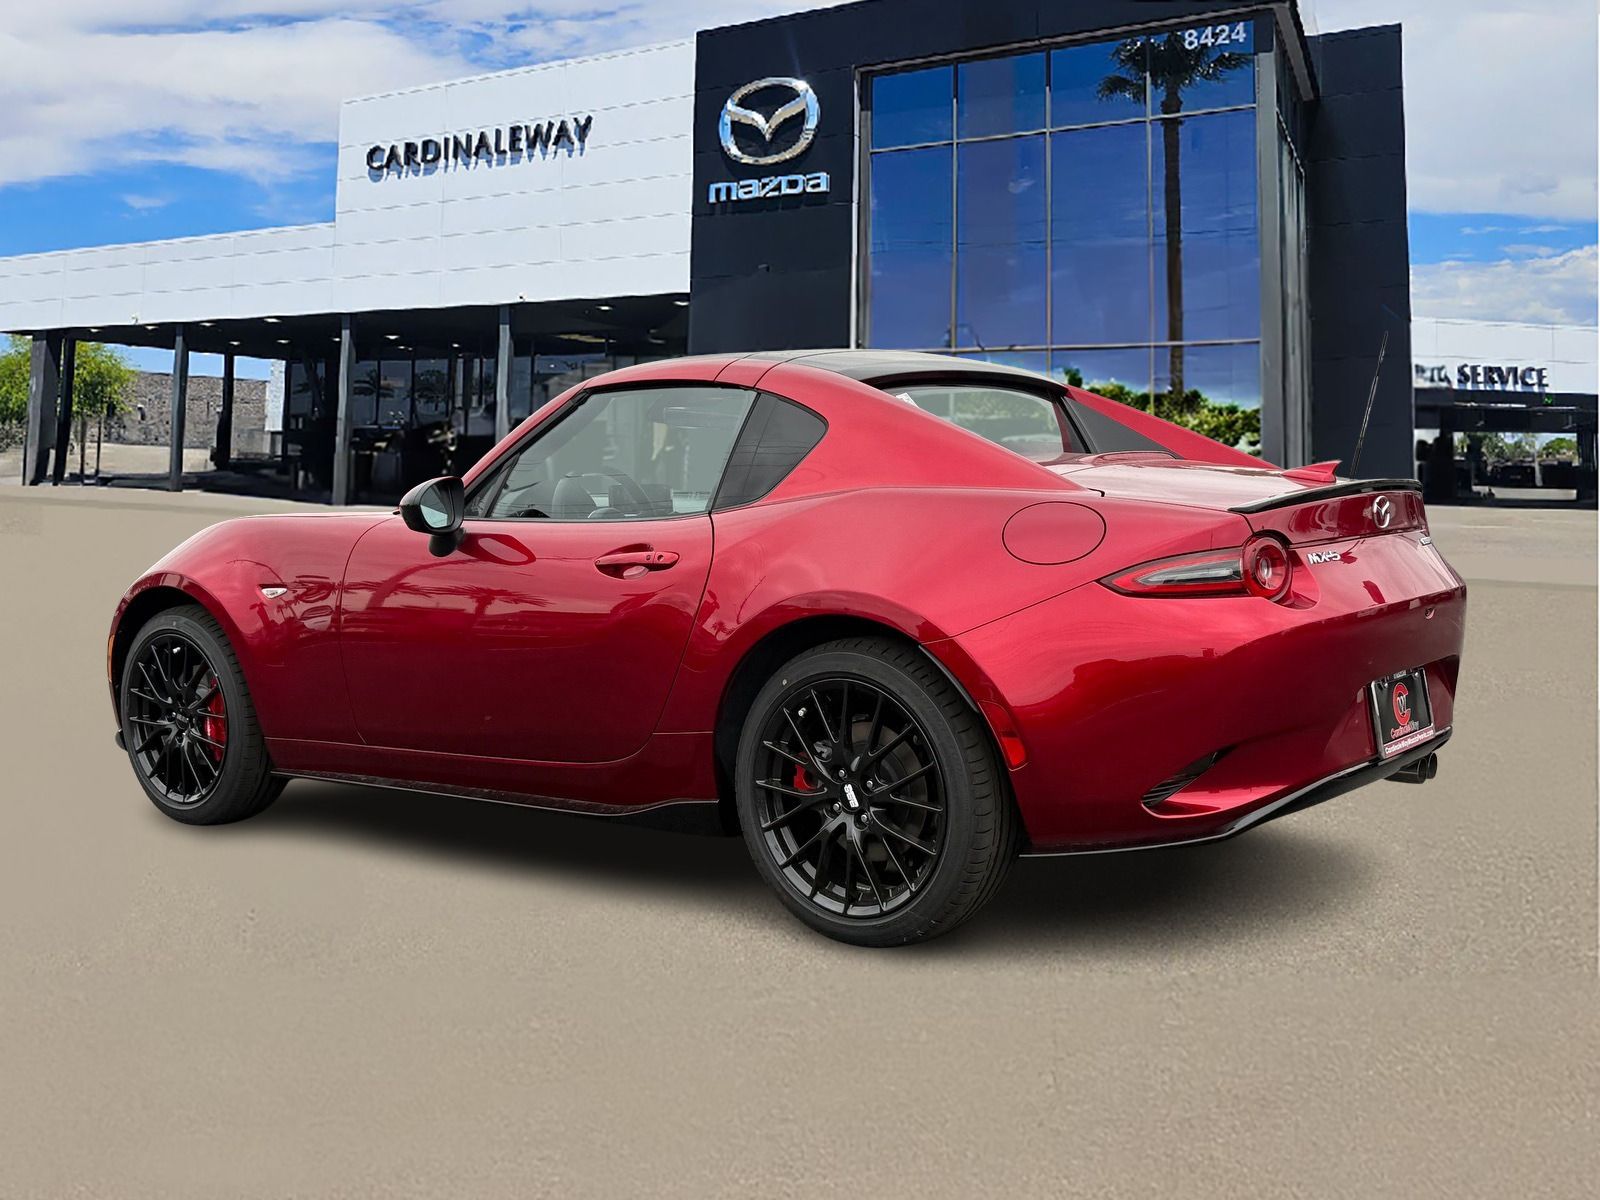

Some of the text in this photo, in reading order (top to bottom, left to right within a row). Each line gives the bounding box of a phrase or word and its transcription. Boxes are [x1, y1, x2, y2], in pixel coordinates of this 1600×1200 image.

[1184, 21, 1246, 50] 8424
[366, 114, 593, 171] CARDINALEWAY
[1457, 363, 1549, 388] SERVICE
[1307, 550, 1341, 565] MX-5
